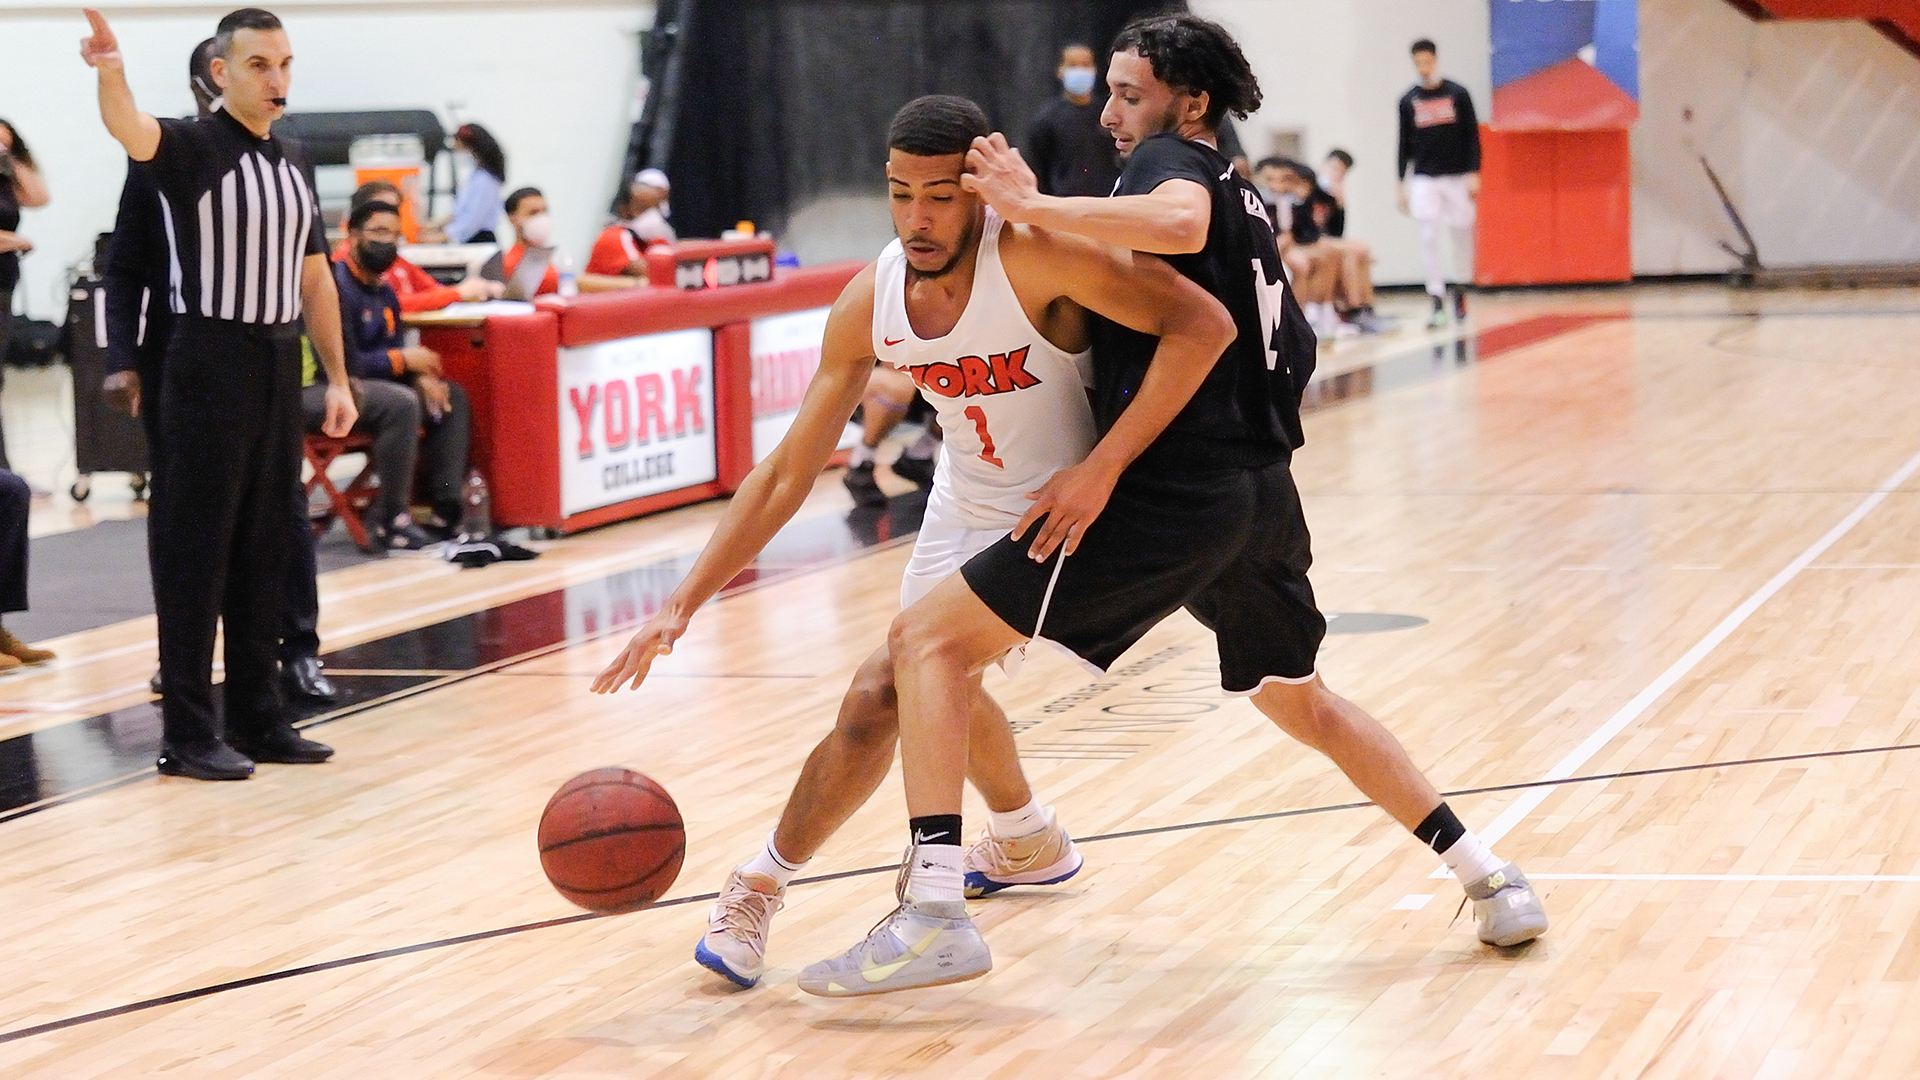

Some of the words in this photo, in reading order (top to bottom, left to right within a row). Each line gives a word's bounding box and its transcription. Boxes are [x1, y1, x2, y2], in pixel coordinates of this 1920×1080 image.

[896, 344, 1042, 398] YORK
[569, 365, 704, 460] YORK
[964, 405, 1004, 469] 1
[603, 451, 675, 490] COLLEGE
